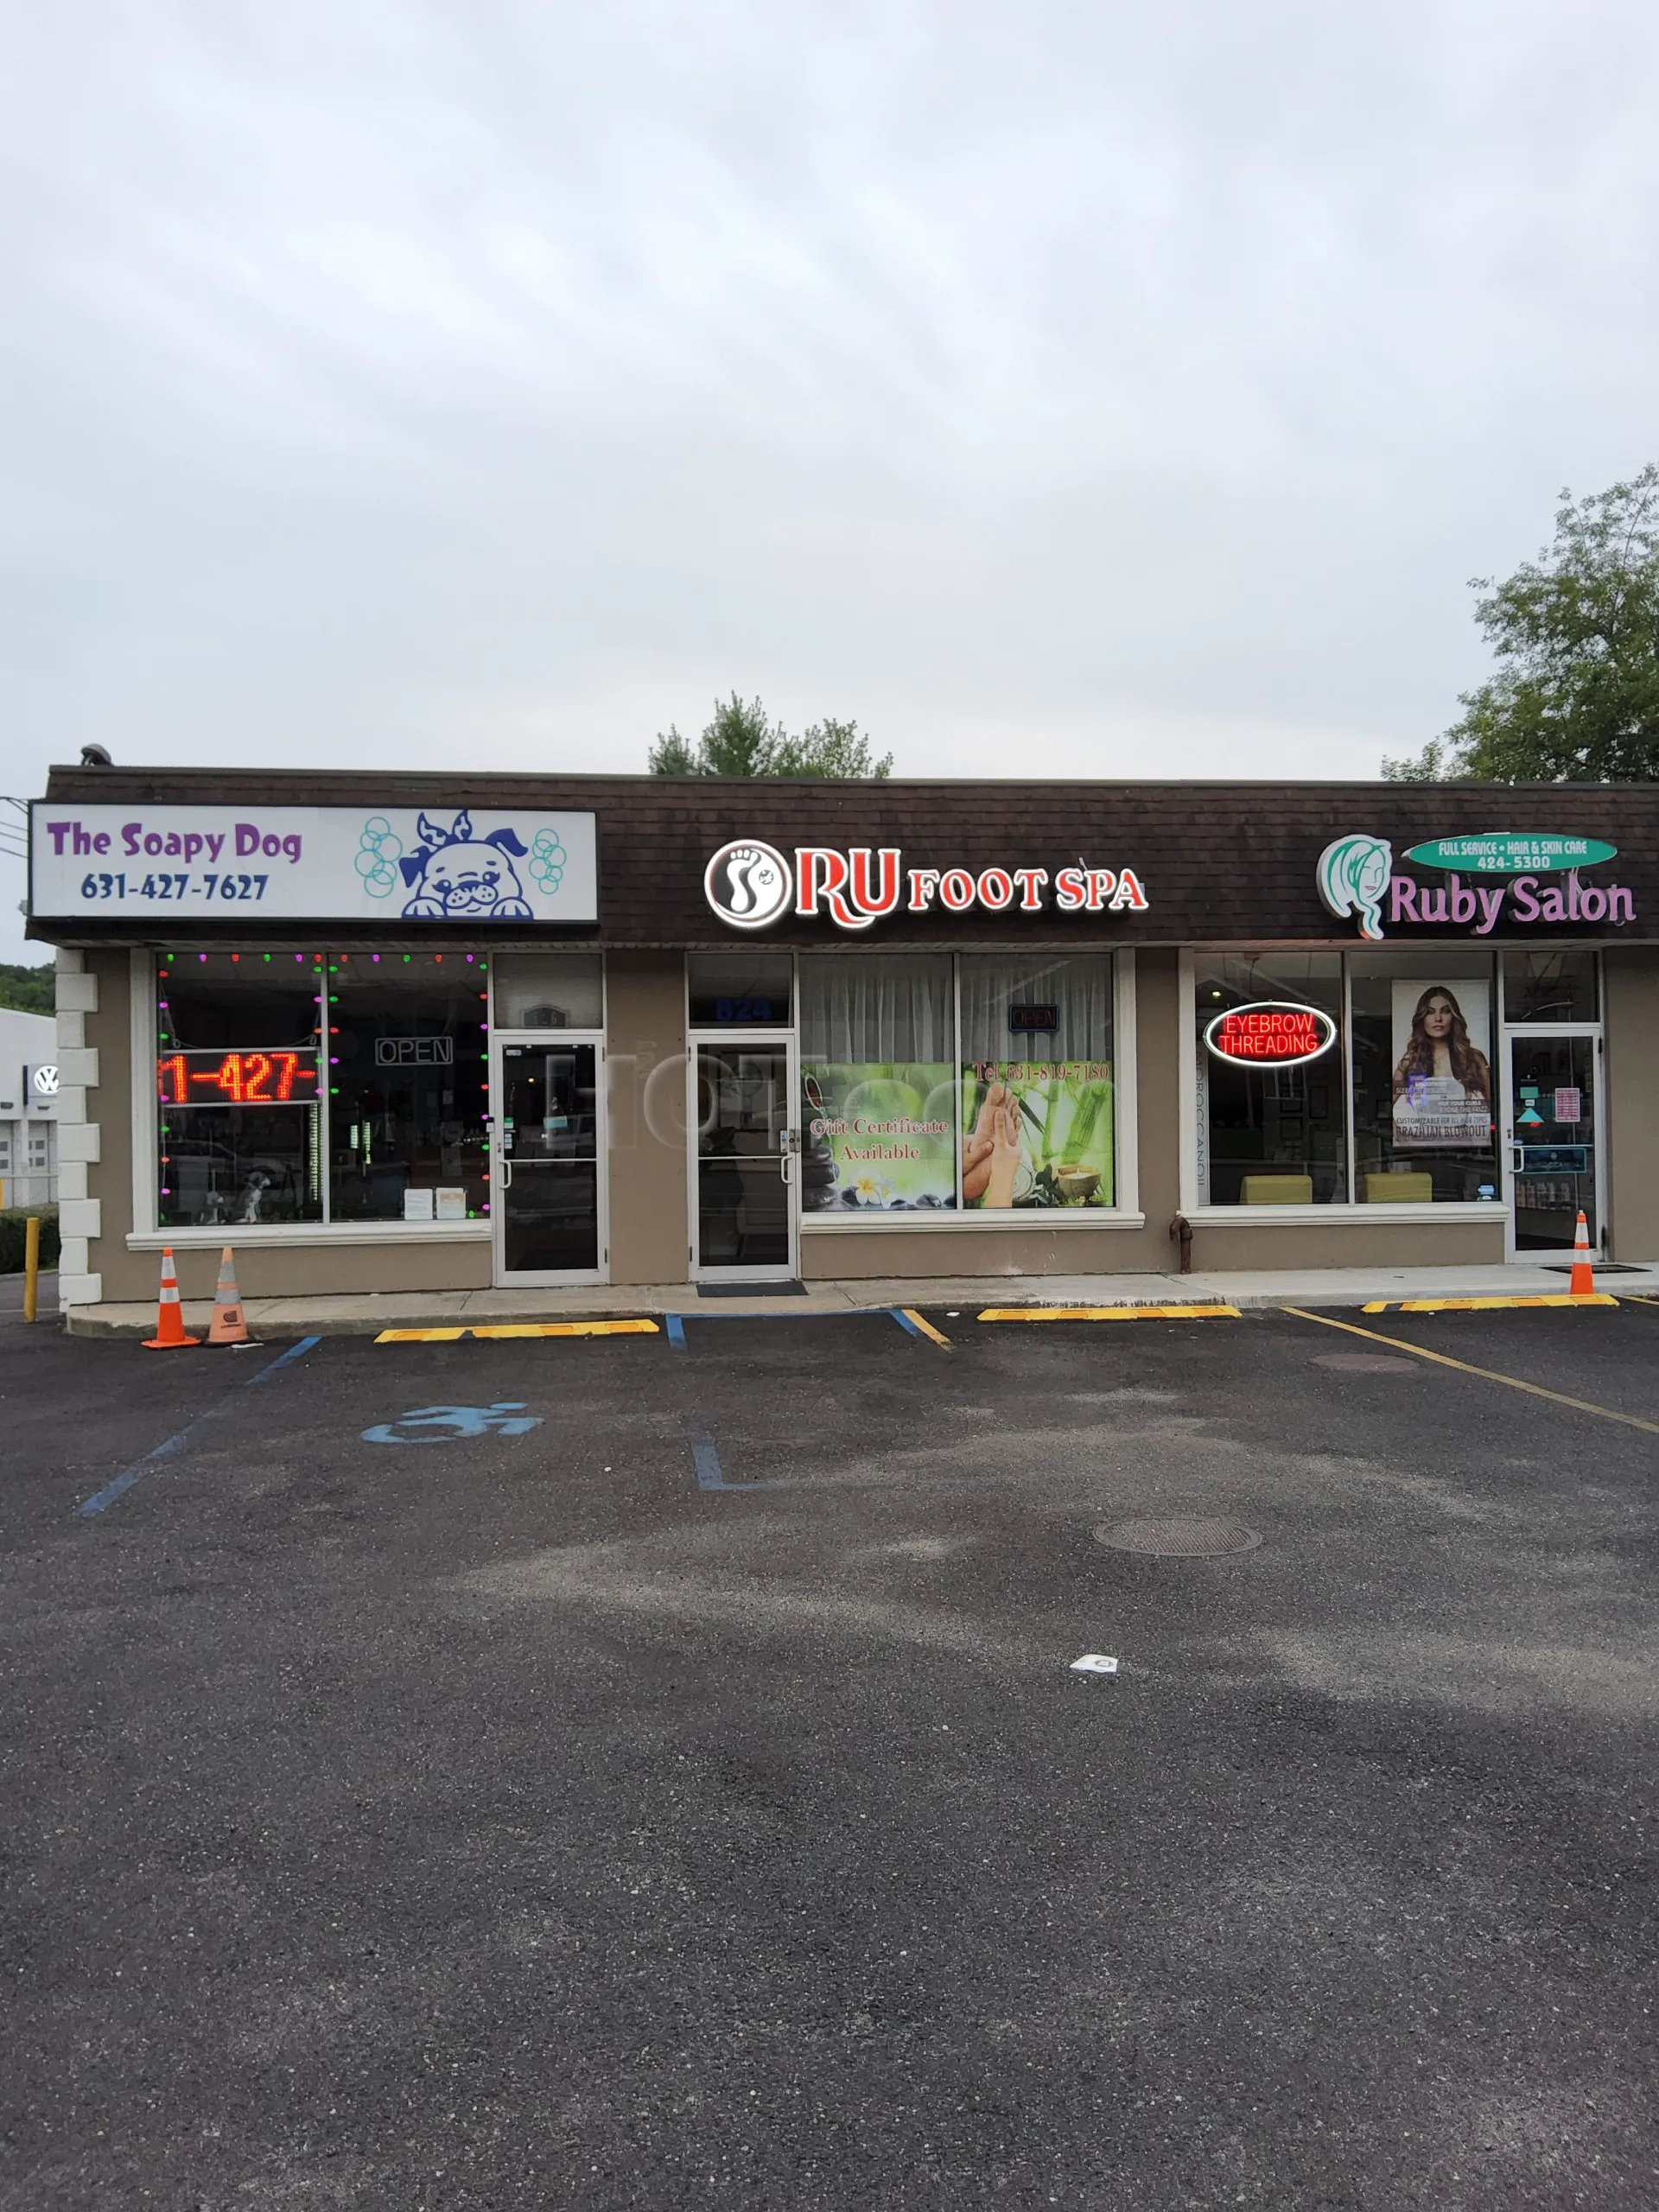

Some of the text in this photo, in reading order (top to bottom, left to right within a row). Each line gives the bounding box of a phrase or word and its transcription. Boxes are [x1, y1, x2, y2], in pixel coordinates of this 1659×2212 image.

[47, 822, 302, 865] The Soapy Dog
[1439, 841, 1587, 855] FULL SERVICE HAIR & SKIN CARE
[81, 874, 269, 899] 631-427-7627
[794, 848, 1149, 929] RU FOOT SPA
[1390, 873, 1637, 935] Ruby Salon
[715, 997, 772, 1020] 824
[1013, 1008, 1056, 1027] OPEN
[1225, 1014, 1314, 1033] EYEBROW
[379, 1039, 449, 1063] OPEN
[1218, 1034, 1319, 1054] THREADING
[1006, 1064, 1109, 1080] 631-819-7180
[810, 1117, 949, 1135] Gift Certificate
[1396, 1125, 1486, 1138] BRAZILIAN BLOWOUT
[840, 1144, 920, 1160] Available
